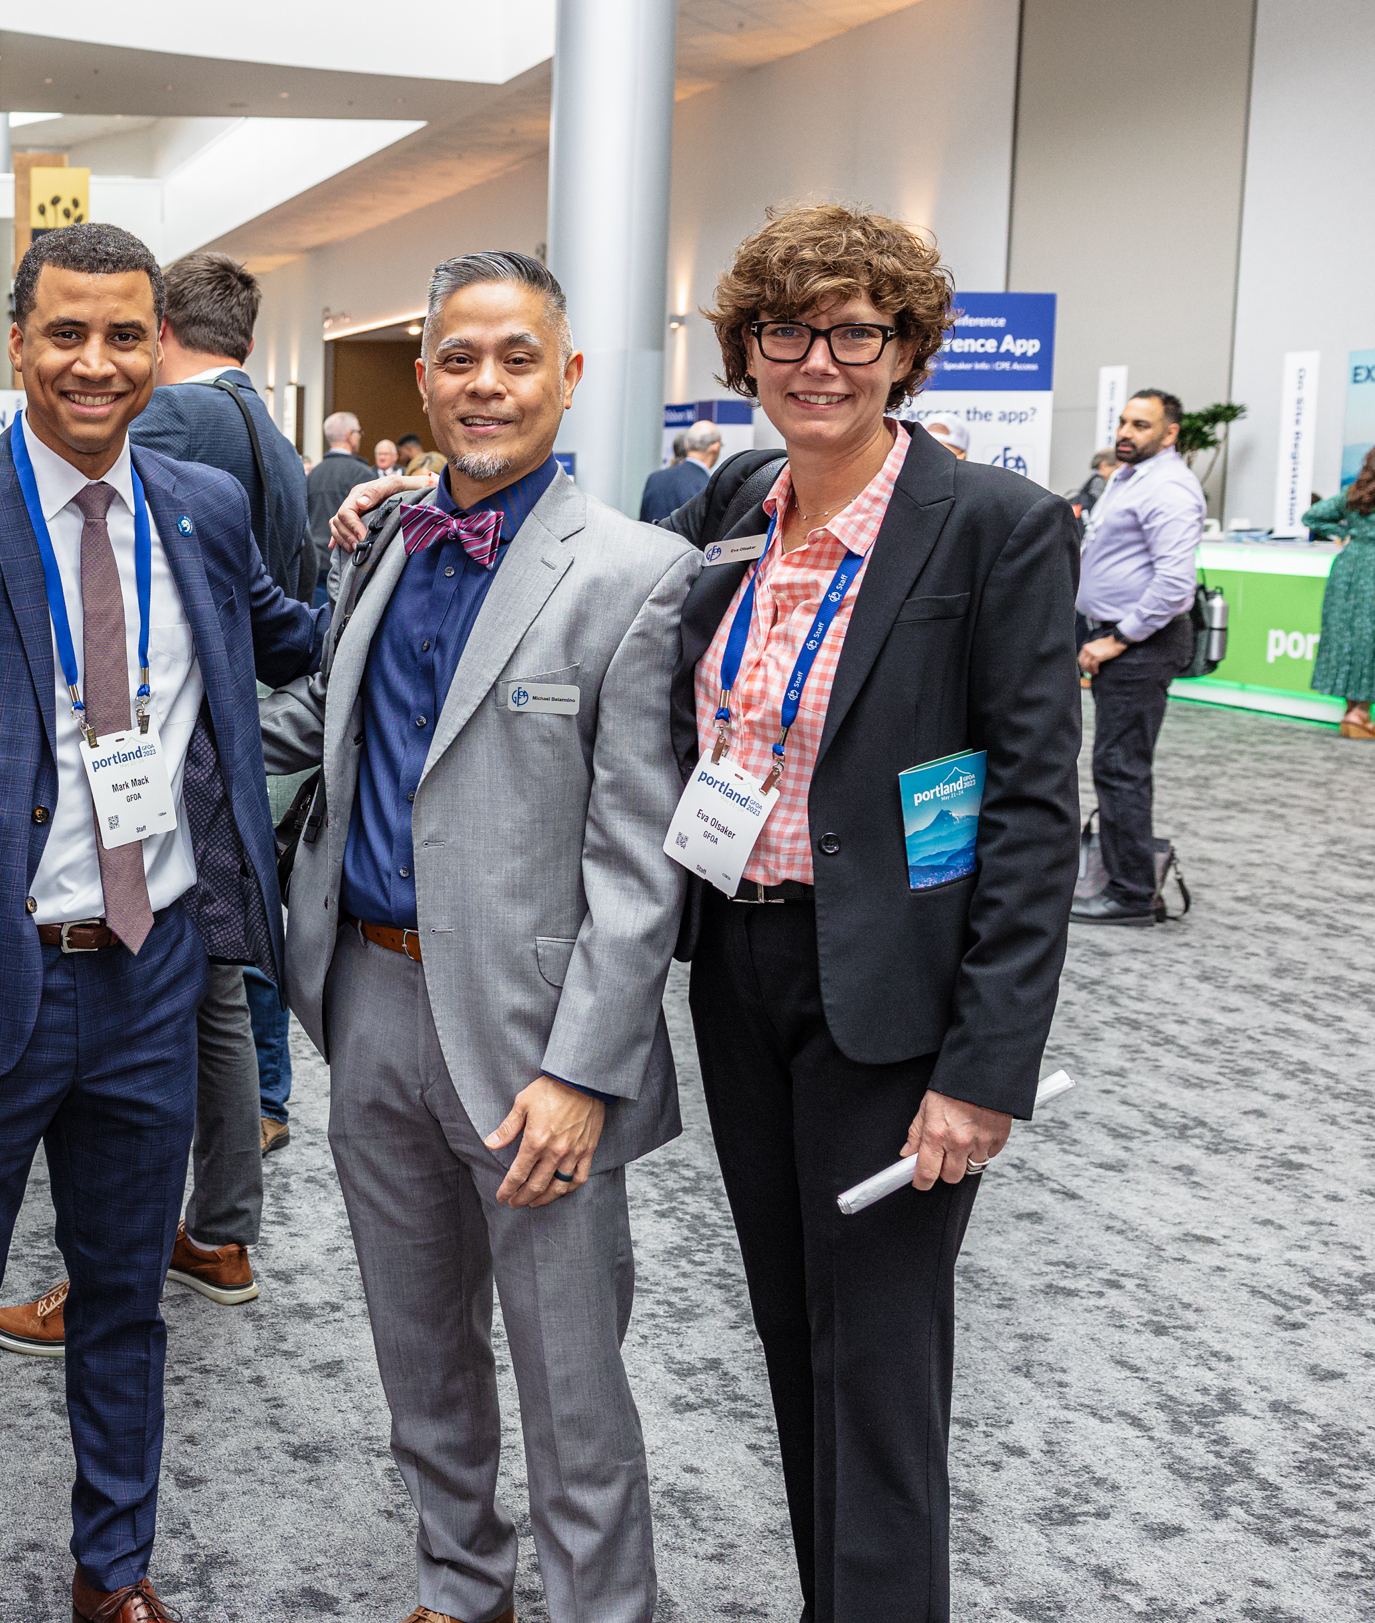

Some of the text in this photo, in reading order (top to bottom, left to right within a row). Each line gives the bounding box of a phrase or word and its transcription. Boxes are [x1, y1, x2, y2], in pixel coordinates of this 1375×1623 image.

[999, 334, 1041, 357] App
[966, 407, 993, 421] the
[998, 408, 1037, 424] app?
[1288, 431, 1301, 527] Registration
[836, 574, 848, 591] Staff
[813, 622, 825, 639] Staff
[793, 671, 804, 688] Staff
[92, 746, 143, 772] portland
[111, 775, 150, 793] Mark Mack
[697, 770, 751, 808] portland
[913, 776, 963, 806] portland
[126, 792, 142, 803] GFOA
[136, 825, 146, 833] Staff
[696, 808, 736, 840] Eva Olsaker
[702, 830, 719, 846] GFOA
[695, 864, 707, 875] Staff
